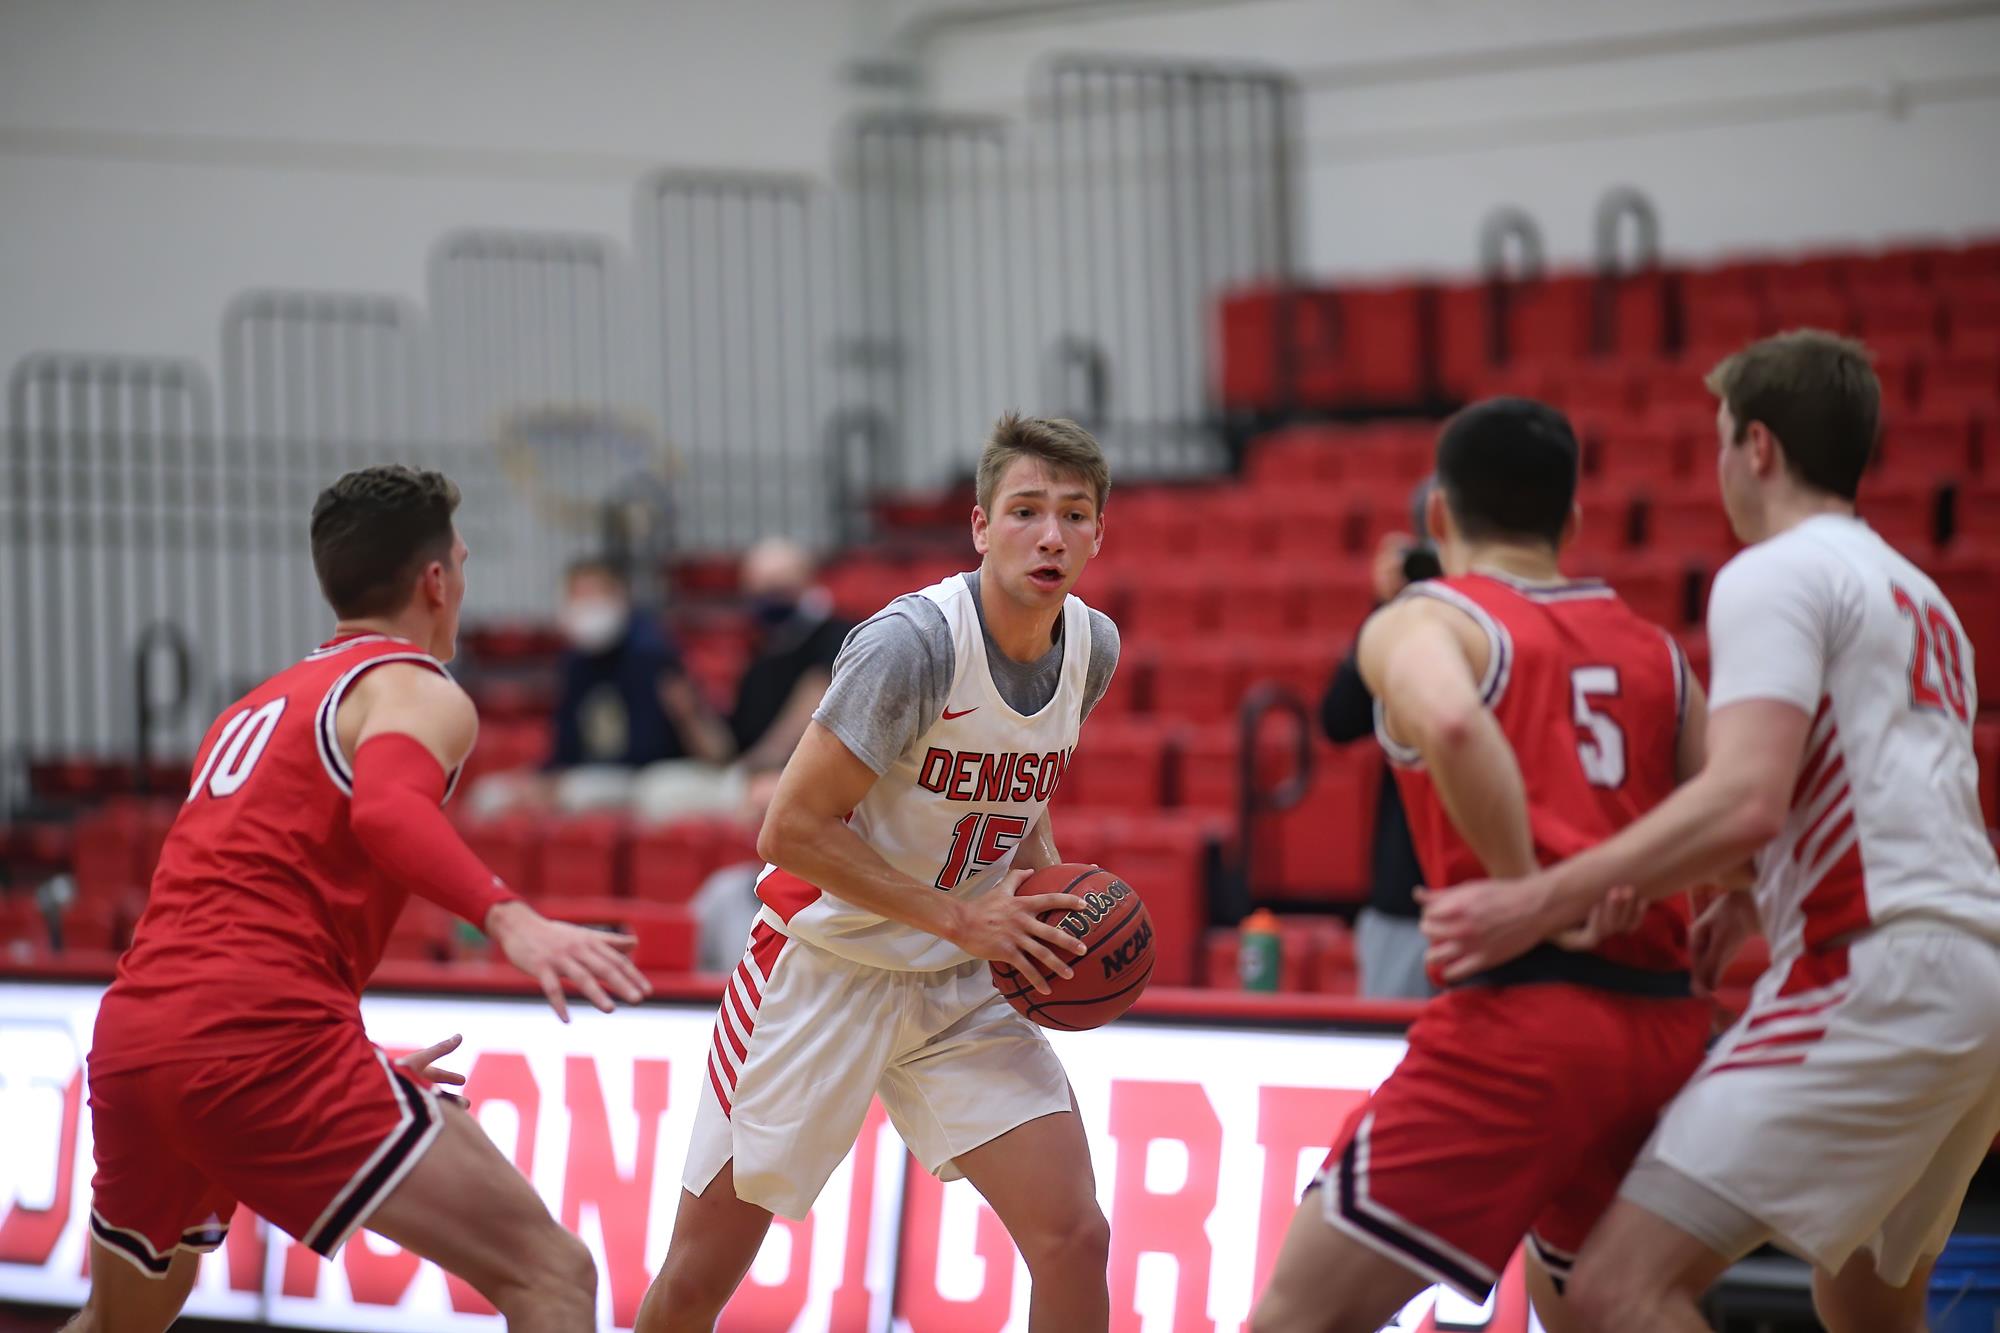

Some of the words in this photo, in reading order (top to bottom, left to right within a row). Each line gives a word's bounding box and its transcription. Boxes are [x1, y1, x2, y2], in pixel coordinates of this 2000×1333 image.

[1891, 580, 1969, 724] 20
[187, 694, 288, 804] 10
[1570, 665, 1626, 789] 5
[935, 812, 1028, 891] 15
[1102, 919, 1153, 979] NCAA
